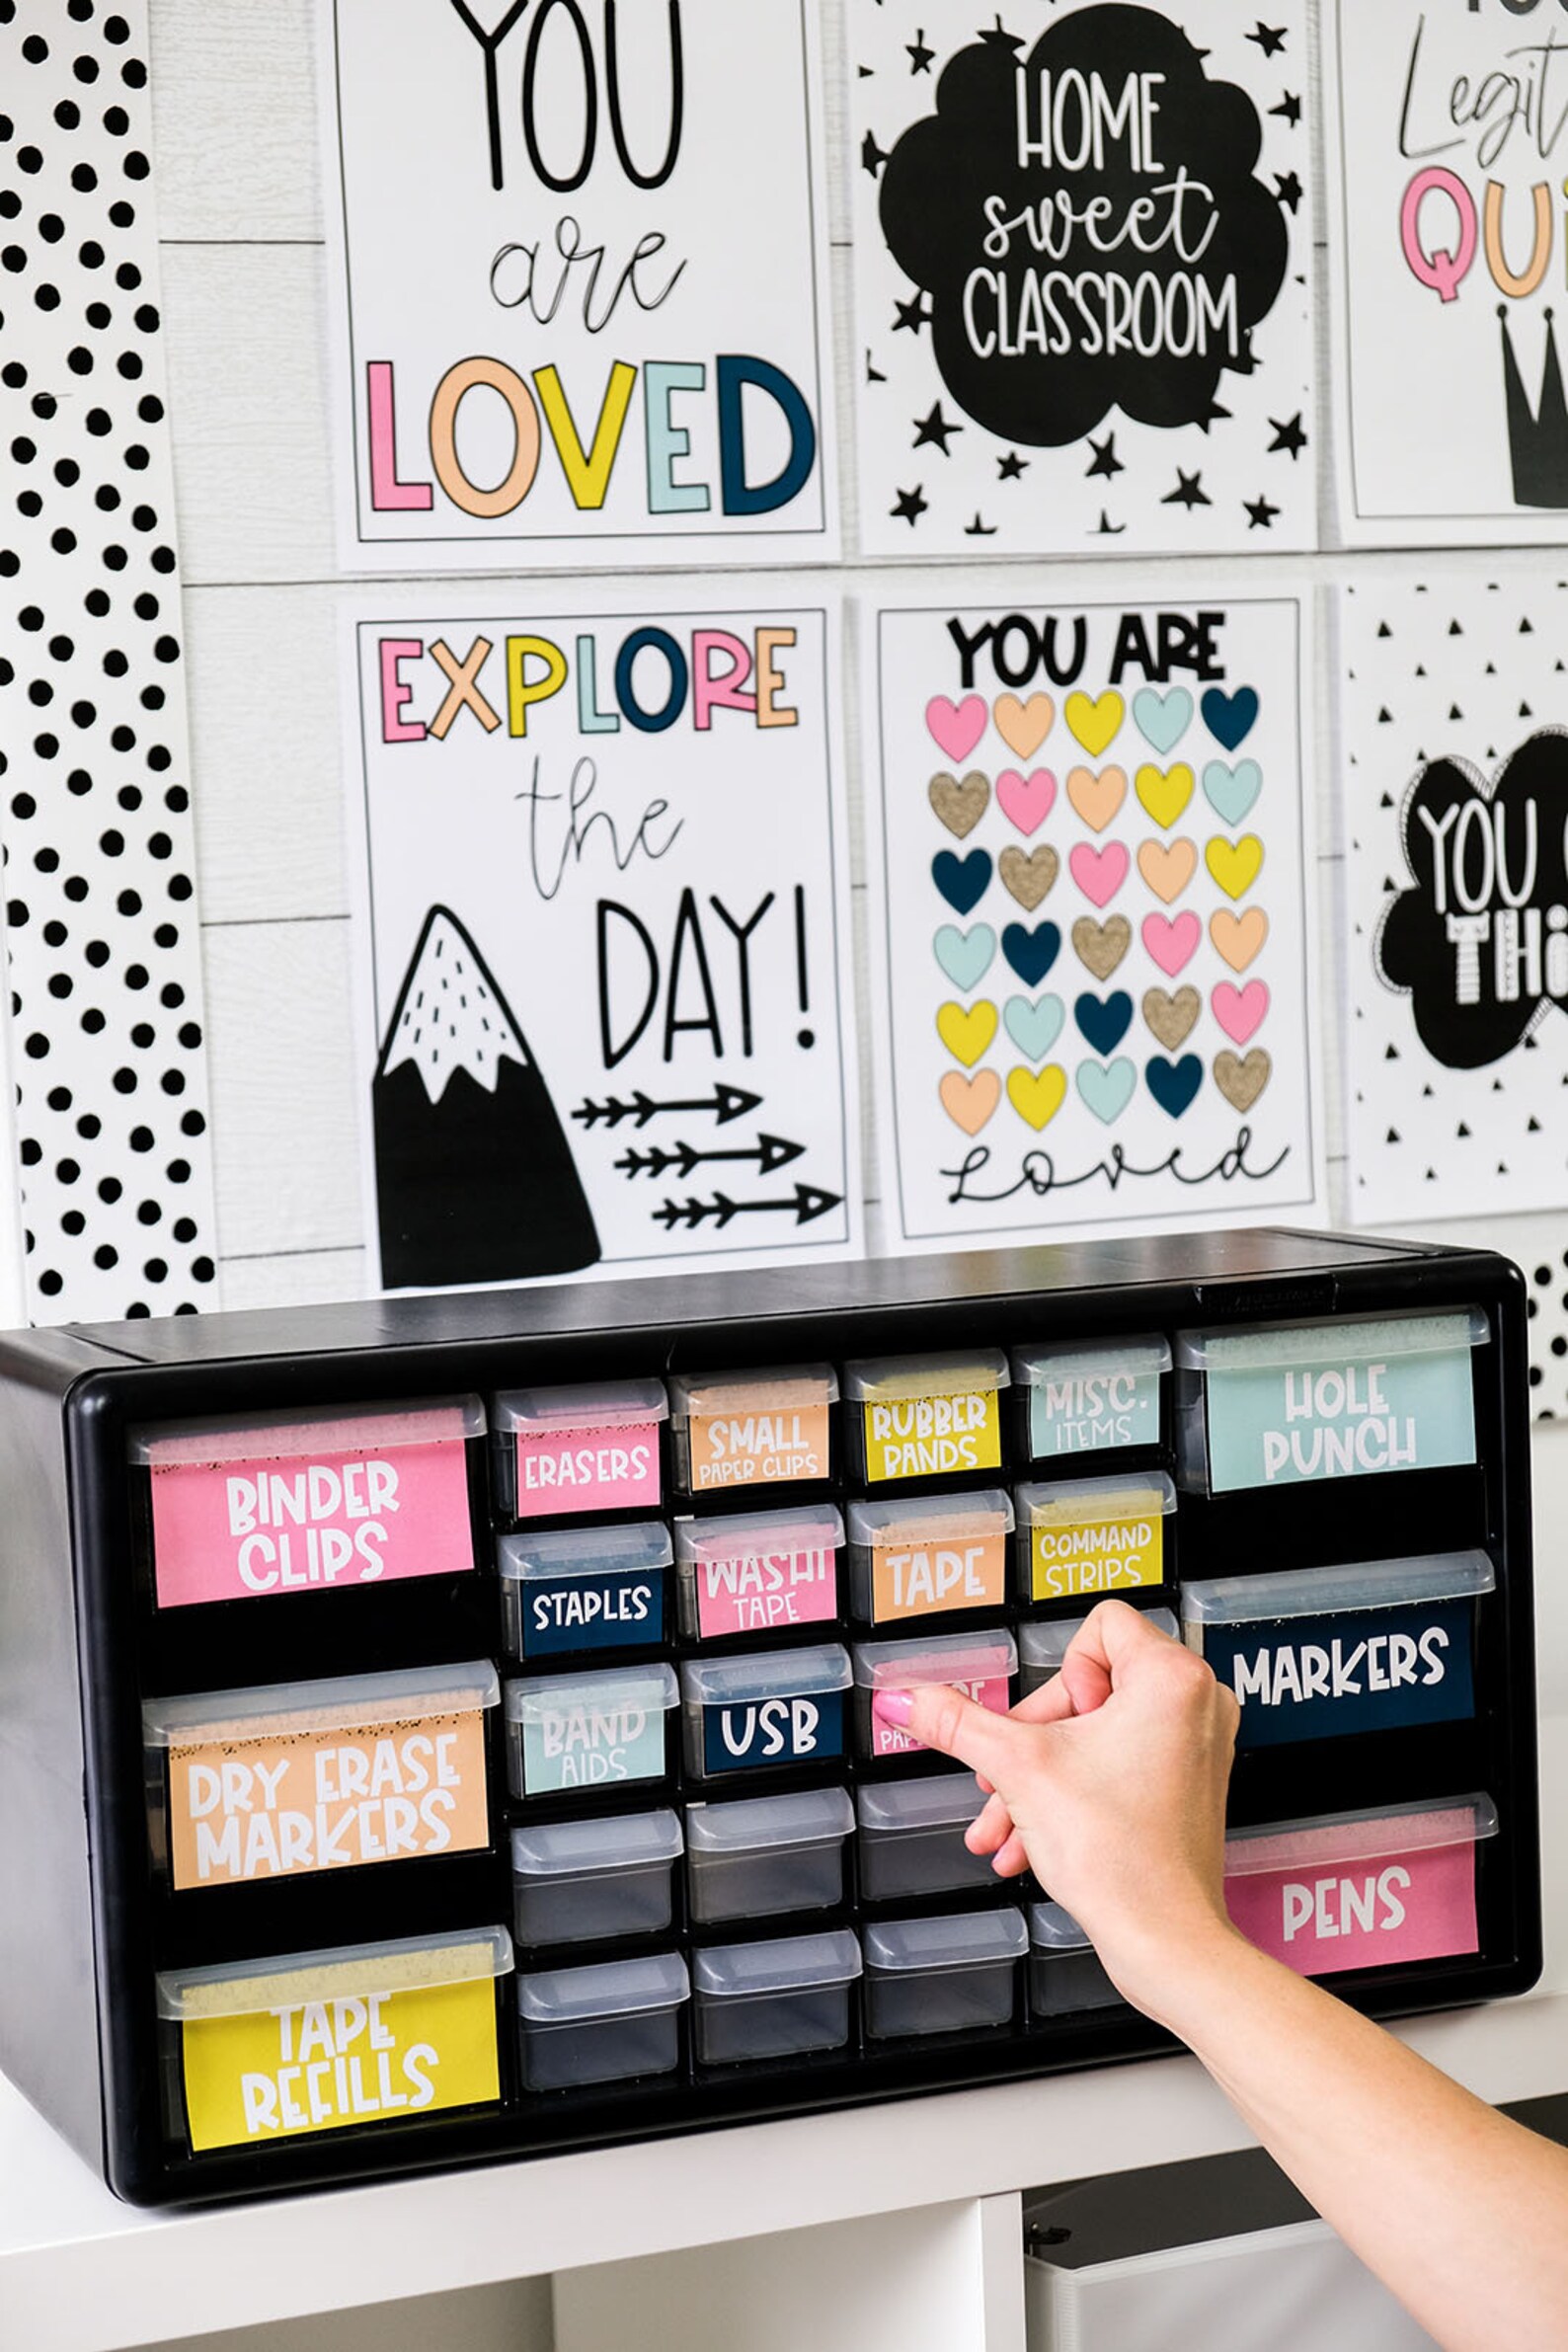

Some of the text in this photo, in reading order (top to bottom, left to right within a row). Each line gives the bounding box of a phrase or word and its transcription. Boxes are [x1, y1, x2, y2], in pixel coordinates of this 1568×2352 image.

[449, 0, 683, 193] YOU
[1015, 66, 1166, 173] HOME
[981, 166, 1219, 262] sweet
[490, 215, 687, 333] are
[962, 267, 1239, 359] CLASSROOM
[366, 353, 816, 518] LOVED
[378, 626, 799, 744] EXPLORE
[946, 611, 1225, 689] YOU ARE
[514, 755, 685, 900] the
[1417, 798, 1537, 914] YOU
[596, 884, 815, 1068] DAY!
[939, 1127, 1291, 1204] Loved
[873, 1395, 987, 1442] RUBBER
[1045, 1372, 1148, 1420] MISC.
[1285, 1363, 1388, 1423] HOLE
[524, 1445, 652, 1489] ERASERS
[699, 1453, 819, 1486] PAPER CLIPS
[708, 1416, 809, 1459] SMALL
[1056, 1415, 1133, 1450] ITEMS
[1263, 1417, 1417, 1480] PUNCH
[226, 1460, 401, 1536] BINDER
[237, 1521, 388, 1592] CLIPS
[886, 1546, 986, 1607] TAPE
[1040, 1523, 1152, 1560] COMMAND
[1046, 1555, 1142, 1596] STRIPS
[533, 1585, 653, 1631] STAPLES
[733, 1592, 800, 1629] TAPE
[1232, 1626, 1450, 1706] MARKERS
[542, 1701, 646, 1760] BAND
[720, 1698, 821, 1758] USB
[188, 1733, 461, 1820] DRY ERASE
[561, 1748, 628, 1787] AIDS
[195, 1788, 458, 1880] MARKERS
[1283, 1865, 1411, 1942] PENS
[269, 1992, 396, 2064] TAPE
[241, 2043, 439, 2135] REFILLS
